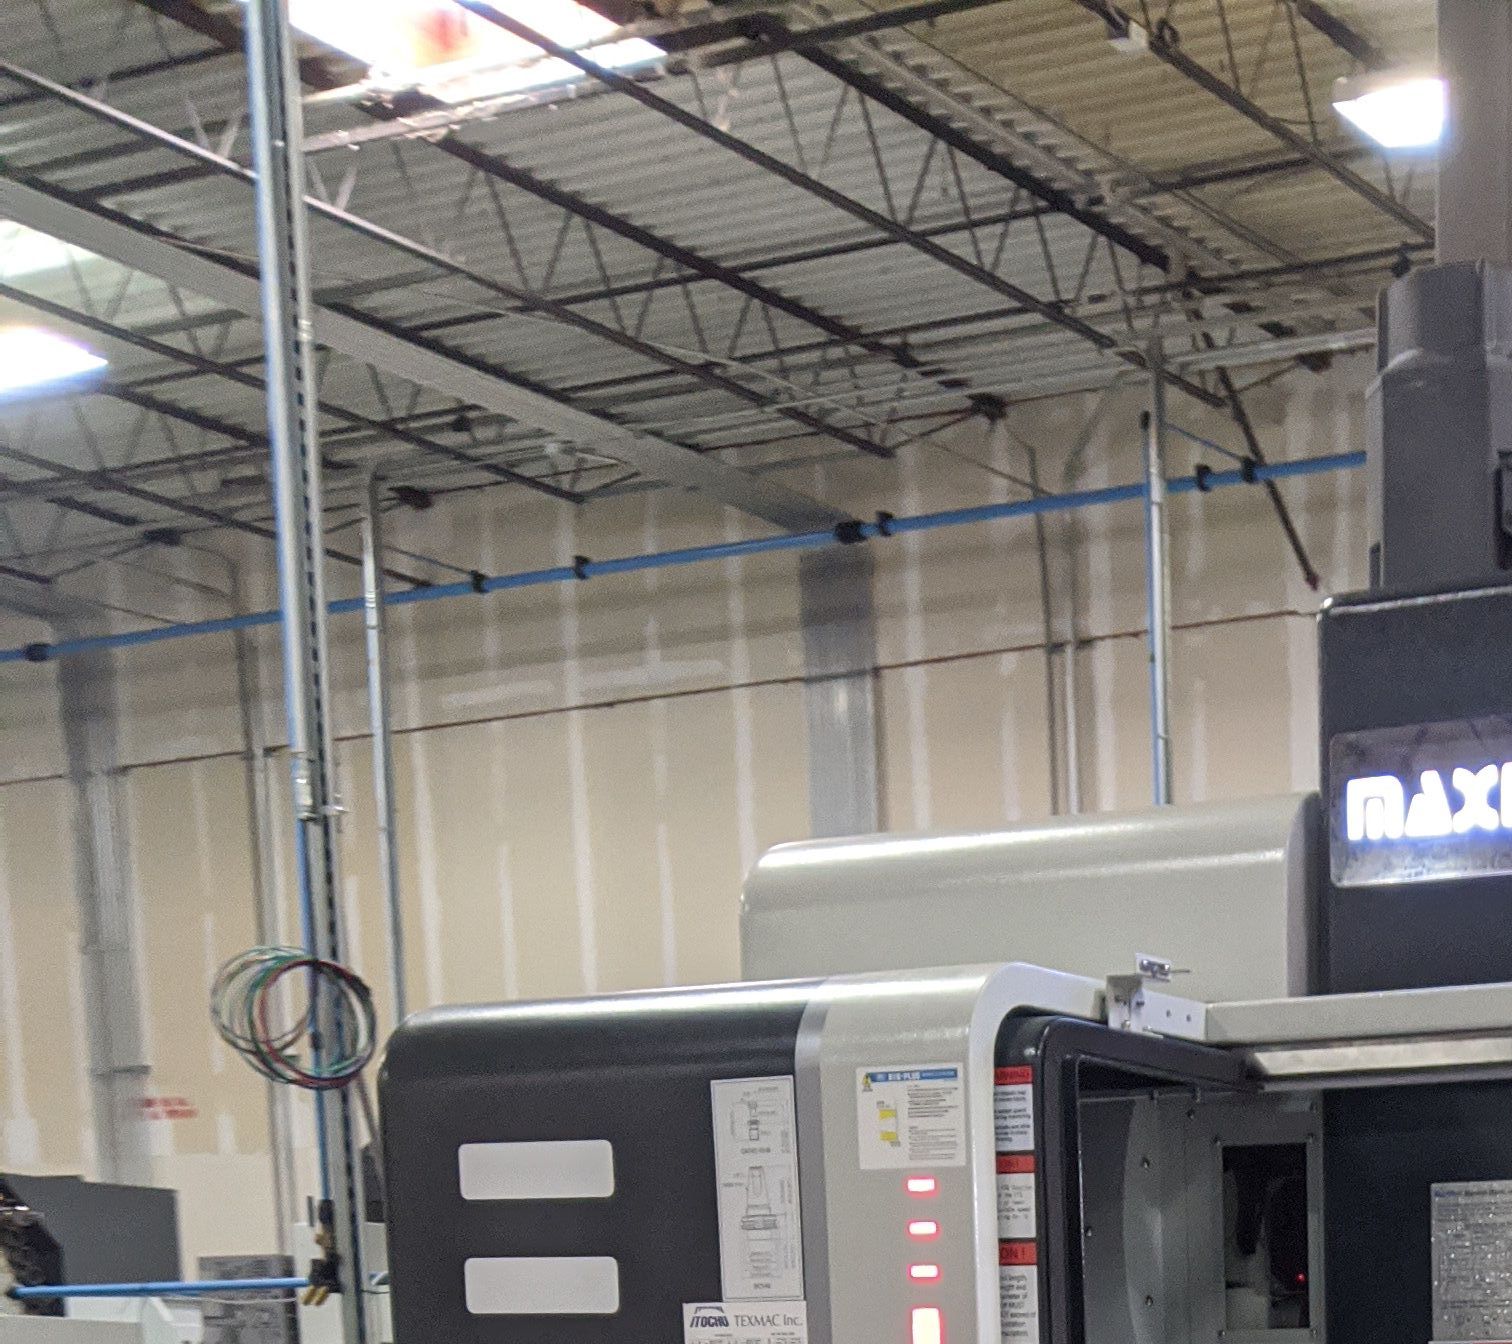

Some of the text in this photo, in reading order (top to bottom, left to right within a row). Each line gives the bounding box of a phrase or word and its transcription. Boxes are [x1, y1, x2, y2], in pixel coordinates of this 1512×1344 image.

[690, 1313, 803, 1328] ITOCHU TEXMAC Inc.
